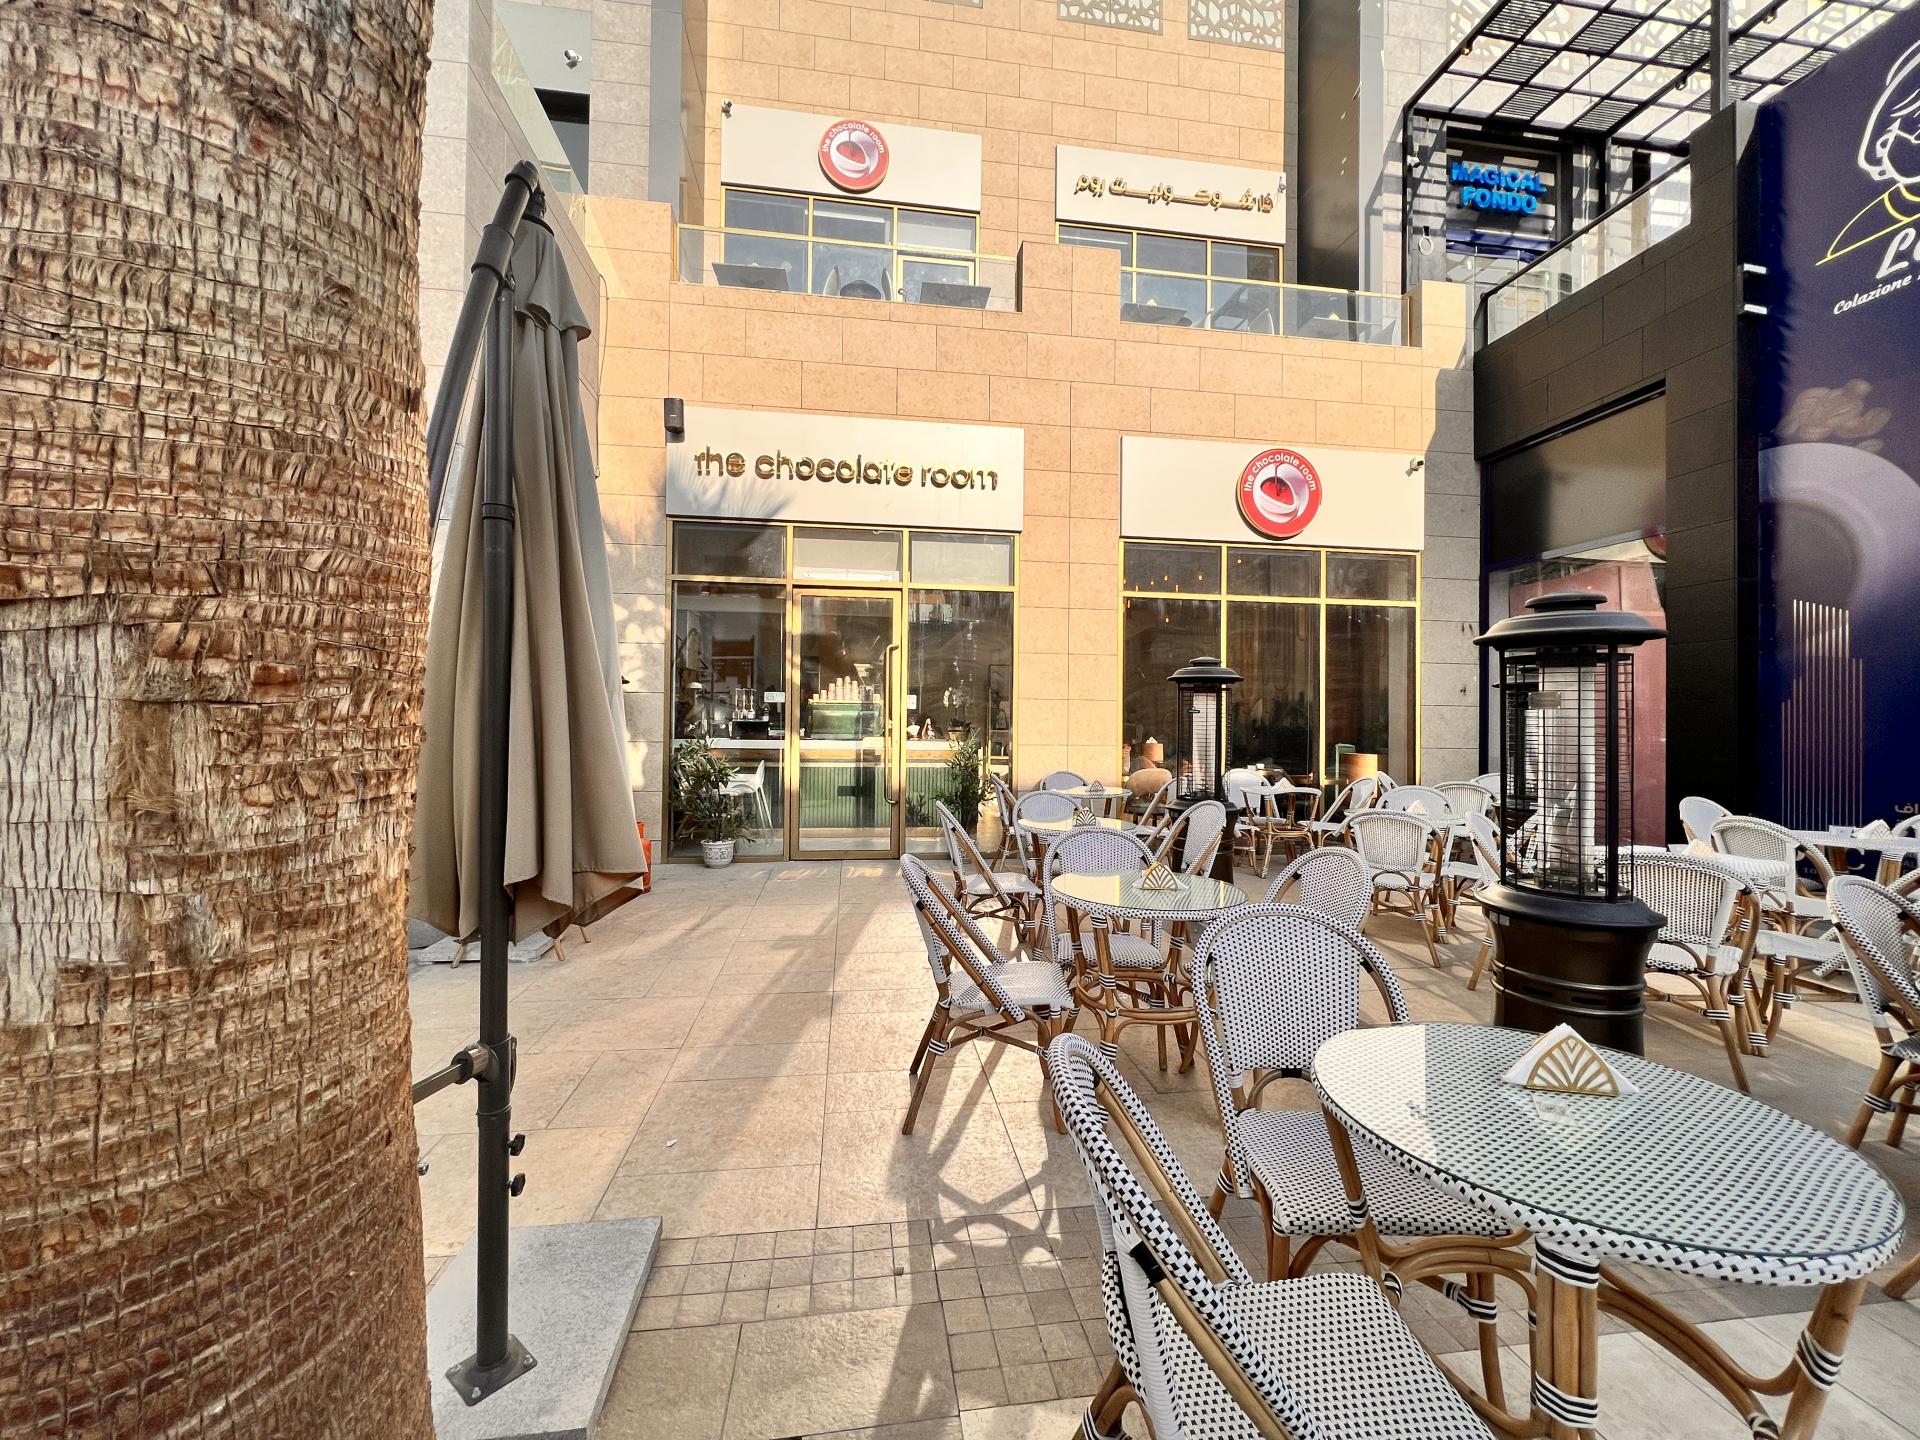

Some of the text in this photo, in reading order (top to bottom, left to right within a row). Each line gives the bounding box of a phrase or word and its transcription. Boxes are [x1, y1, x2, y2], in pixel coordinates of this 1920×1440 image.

[822, 122, 885, 153] the chocolate room
[1074, 174, 1105, 198] روم
[1451, 161, 1548, 193] MAGICAL
[1461, 185, 1538, 214] FONDO
[1875, 227, 1920, 279] L
[1833, 274, 1912, 315] Colazione
[694, 445, 998, 491] the chocolate room
[1244, 453, 1316, 491] the chocolate room
